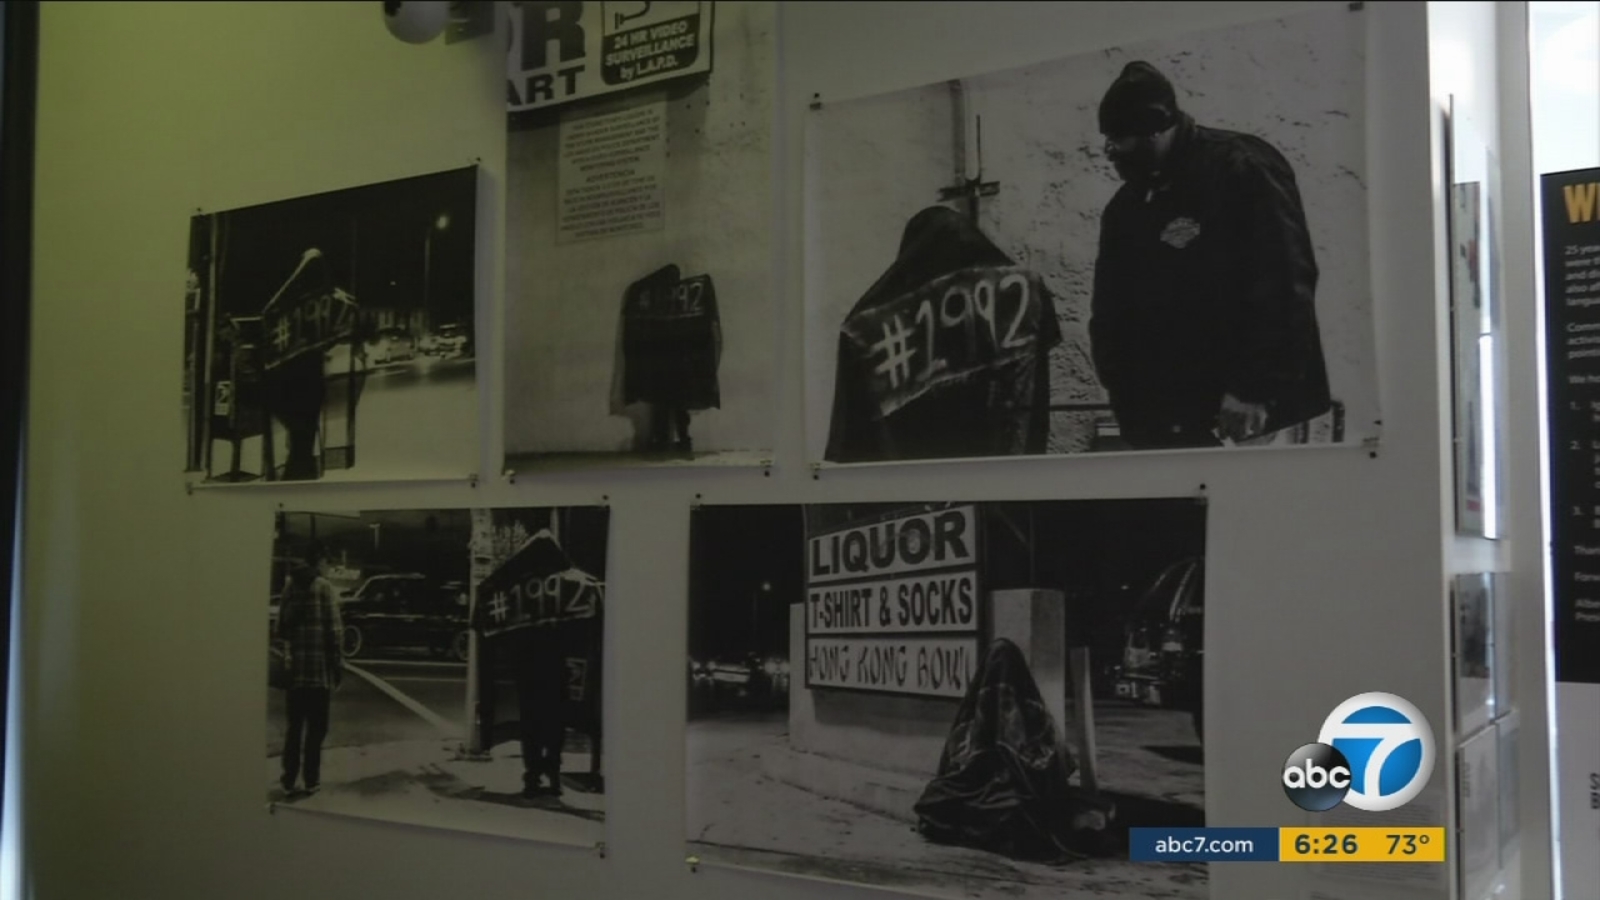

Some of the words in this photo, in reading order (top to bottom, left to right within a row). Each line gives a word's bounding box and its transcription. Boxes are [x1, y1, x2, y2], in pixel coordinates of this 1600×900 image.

[605, 33, 695, 67] SURVEILLANCE
[614, 33, 629, 50] 24
[630, 29, 648, 46] HR
[650, 20, 688, 41] VIDEO
[619, 65, 635, 81] by
[636, 54, 680, 75] L.A.P.D.
[1564, 182, 1600, 224] W
[872, 274, 1037, 389] #1992
[812, 510, 970, 577] LIQUOR
[487, 573, 592, 623] #1992
[810, 587, 872, 629] T-SHIRT
[879, 586, 891, 627] &
[898, 577, 972, 626] SOCKS
[809, 645, 850, 683] HONG
[857, 645, 908, 688] KONG
